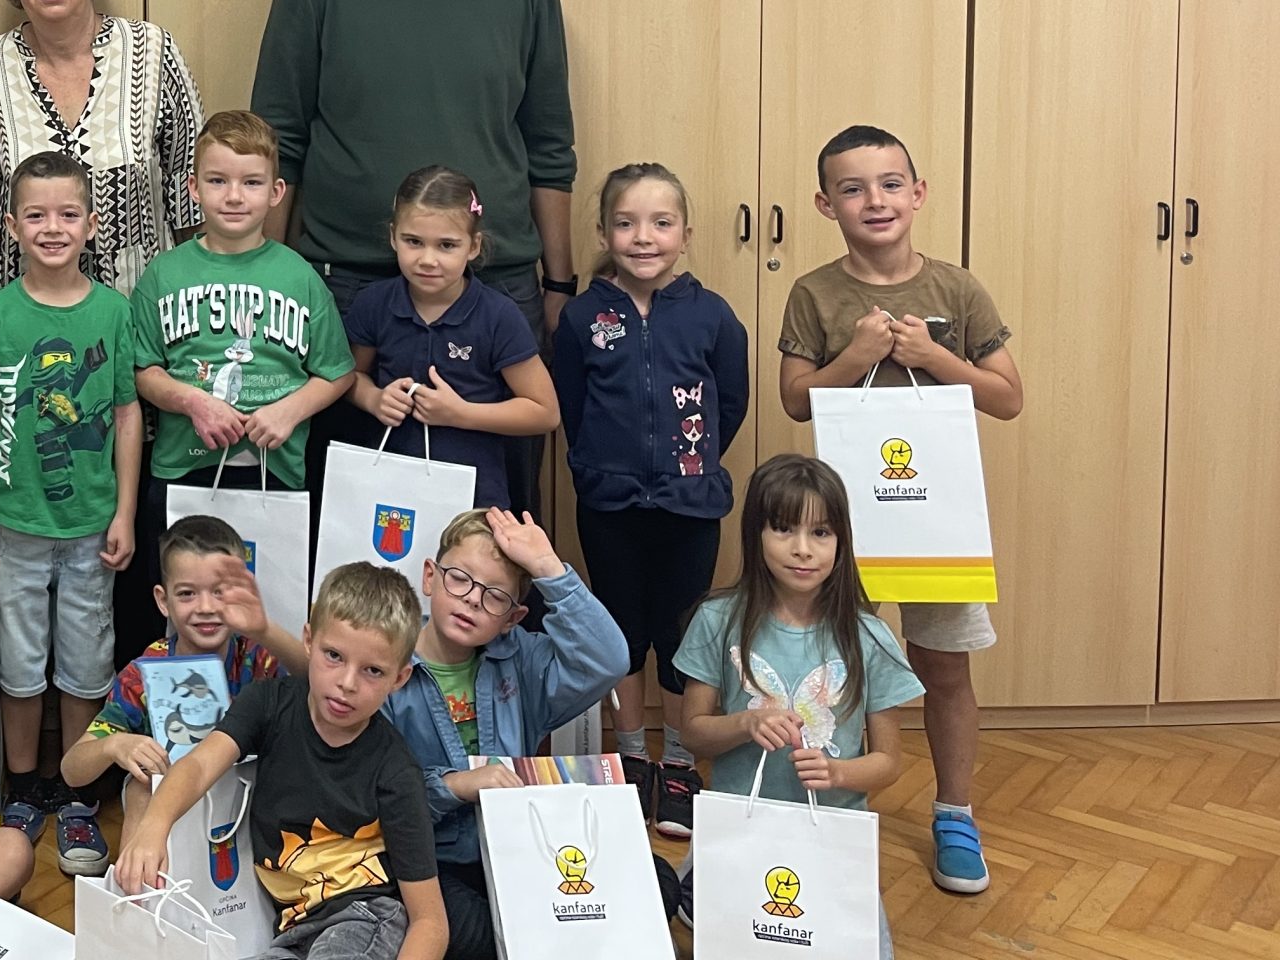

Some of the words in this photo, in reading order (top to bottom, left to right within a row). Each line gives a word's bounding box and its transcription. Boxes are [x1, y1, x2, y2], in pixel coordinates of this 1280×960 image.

[158, 283, 226, 345] HAT'S
[873, 484, 928, 496] kanfanar
[212, 901, 247, 917] Kanfanar
[552, 901, 606, 914] kanfanar
[752, 919, 814, 939] kanfanar
